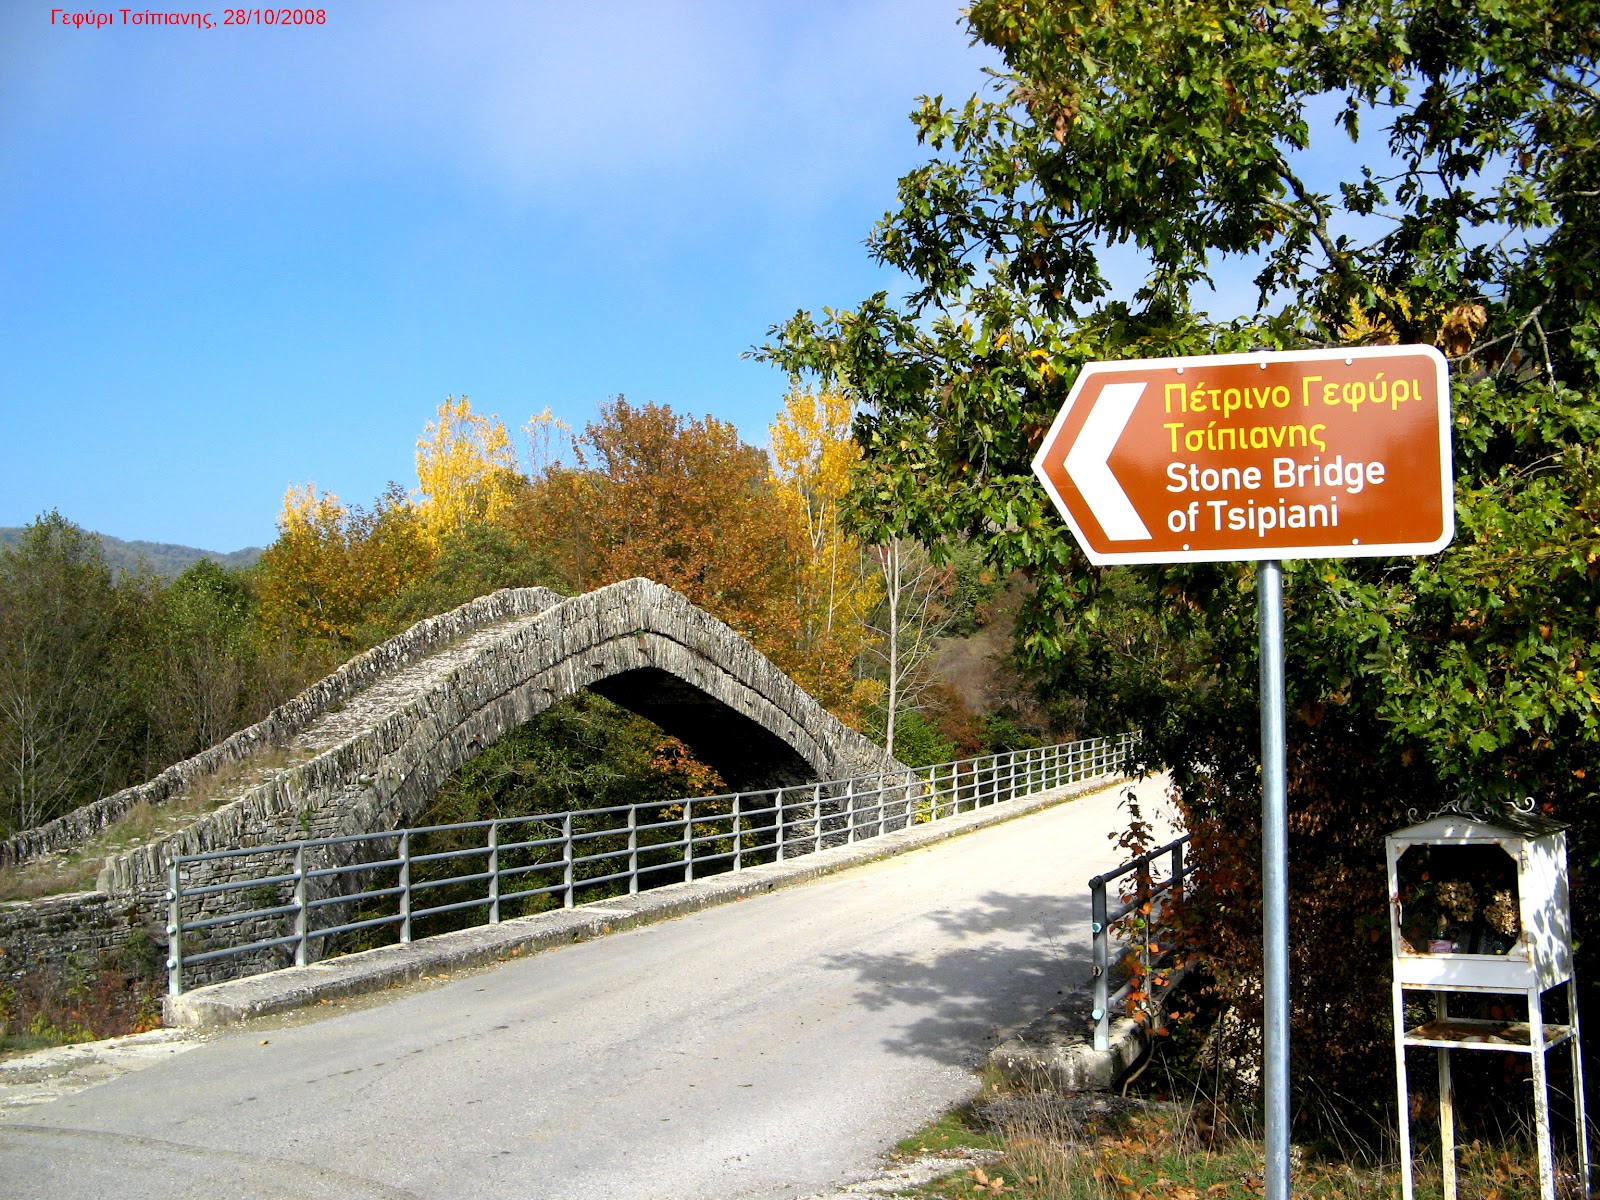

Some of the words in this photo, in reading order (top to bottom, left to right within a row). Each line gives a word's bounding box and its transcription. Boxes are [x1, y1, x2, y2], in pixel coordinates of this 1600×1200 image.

[1164, 382, 1291, 418] Πέτρινο
[1302, 373, 1422, 412] Γεφύρι
[1164, 421, 1326, 453] Τσίπιανης
[1165, 462, 1262, 493] Stone
[1273, 455, 1385, 495] Bridge
[1167, 502, 1200, 533] of
[1206, 496, 1338, 538] Tsipiani
